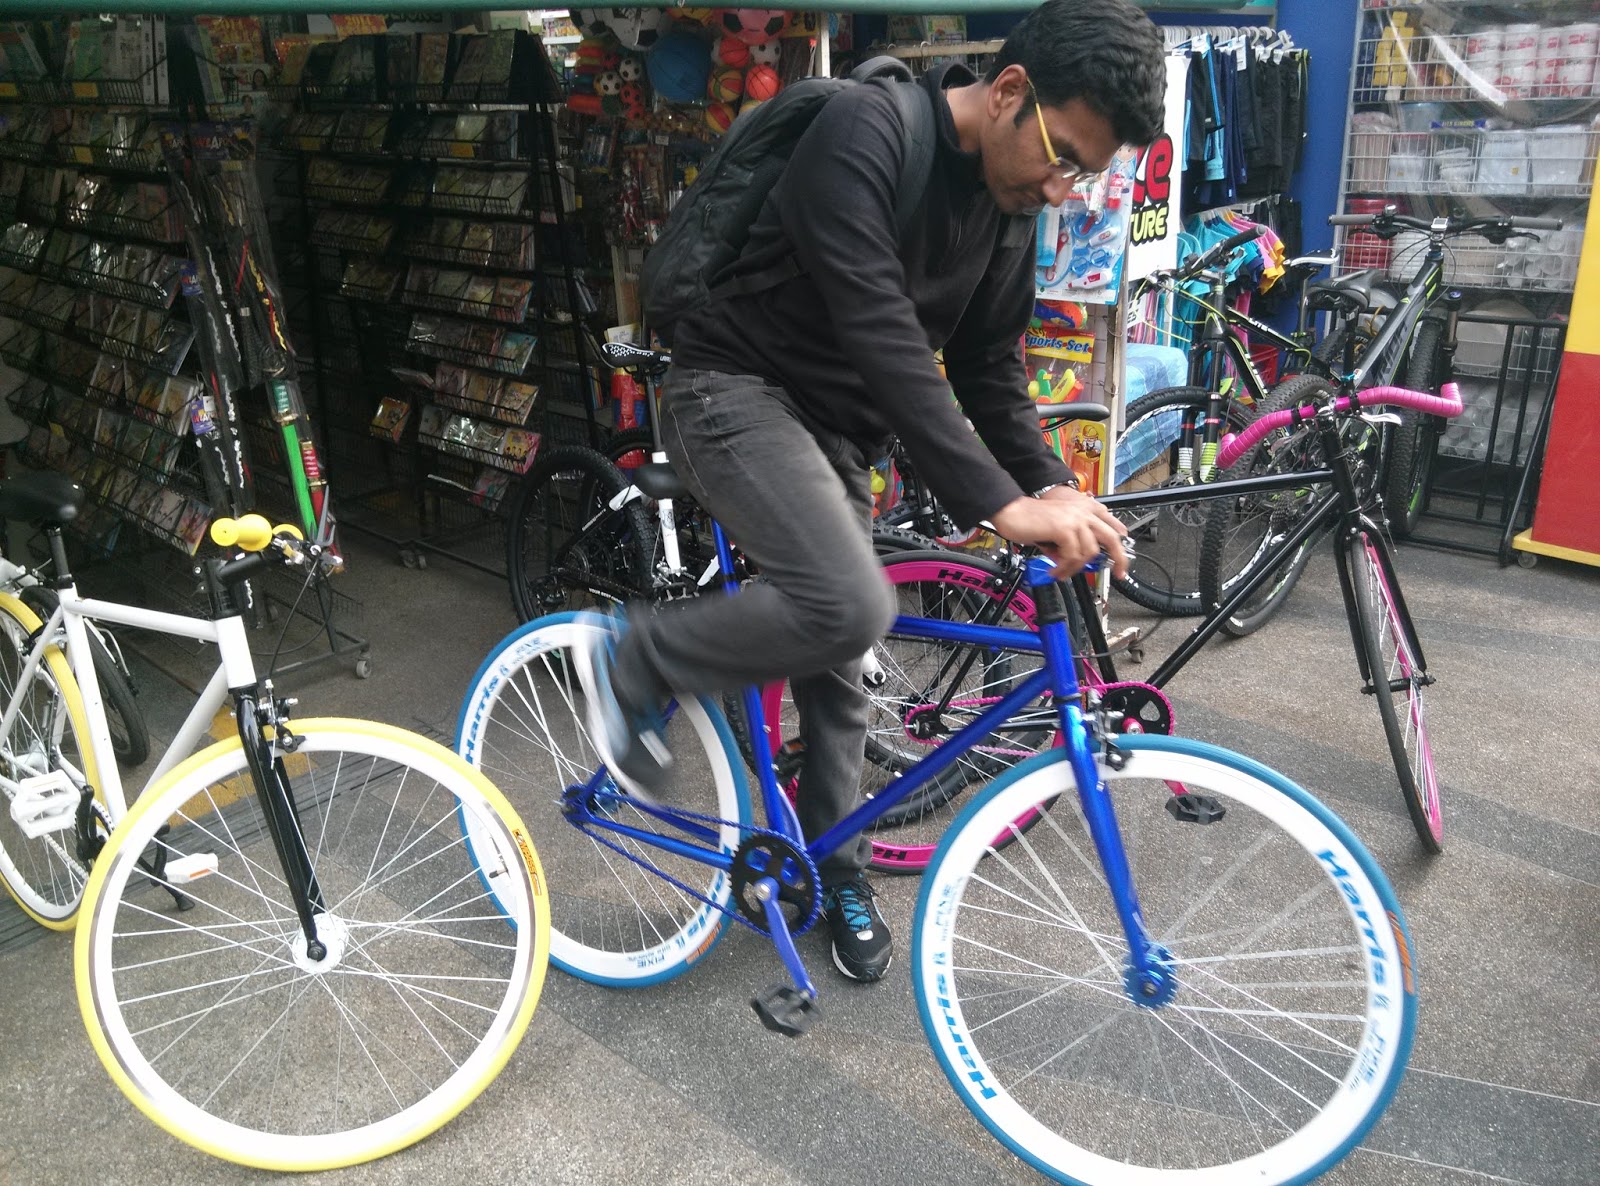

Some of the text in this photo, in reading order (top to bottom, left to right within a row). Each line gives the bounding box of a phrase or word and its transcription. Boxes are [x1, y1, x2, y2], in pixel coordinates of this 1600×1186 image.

[1065, 339, 1091, 353] Set
[464, 675, 500, 764] Harris
[1317, 849, 1388, 986] Harris
[936, 973, 998, 1100] Harris
